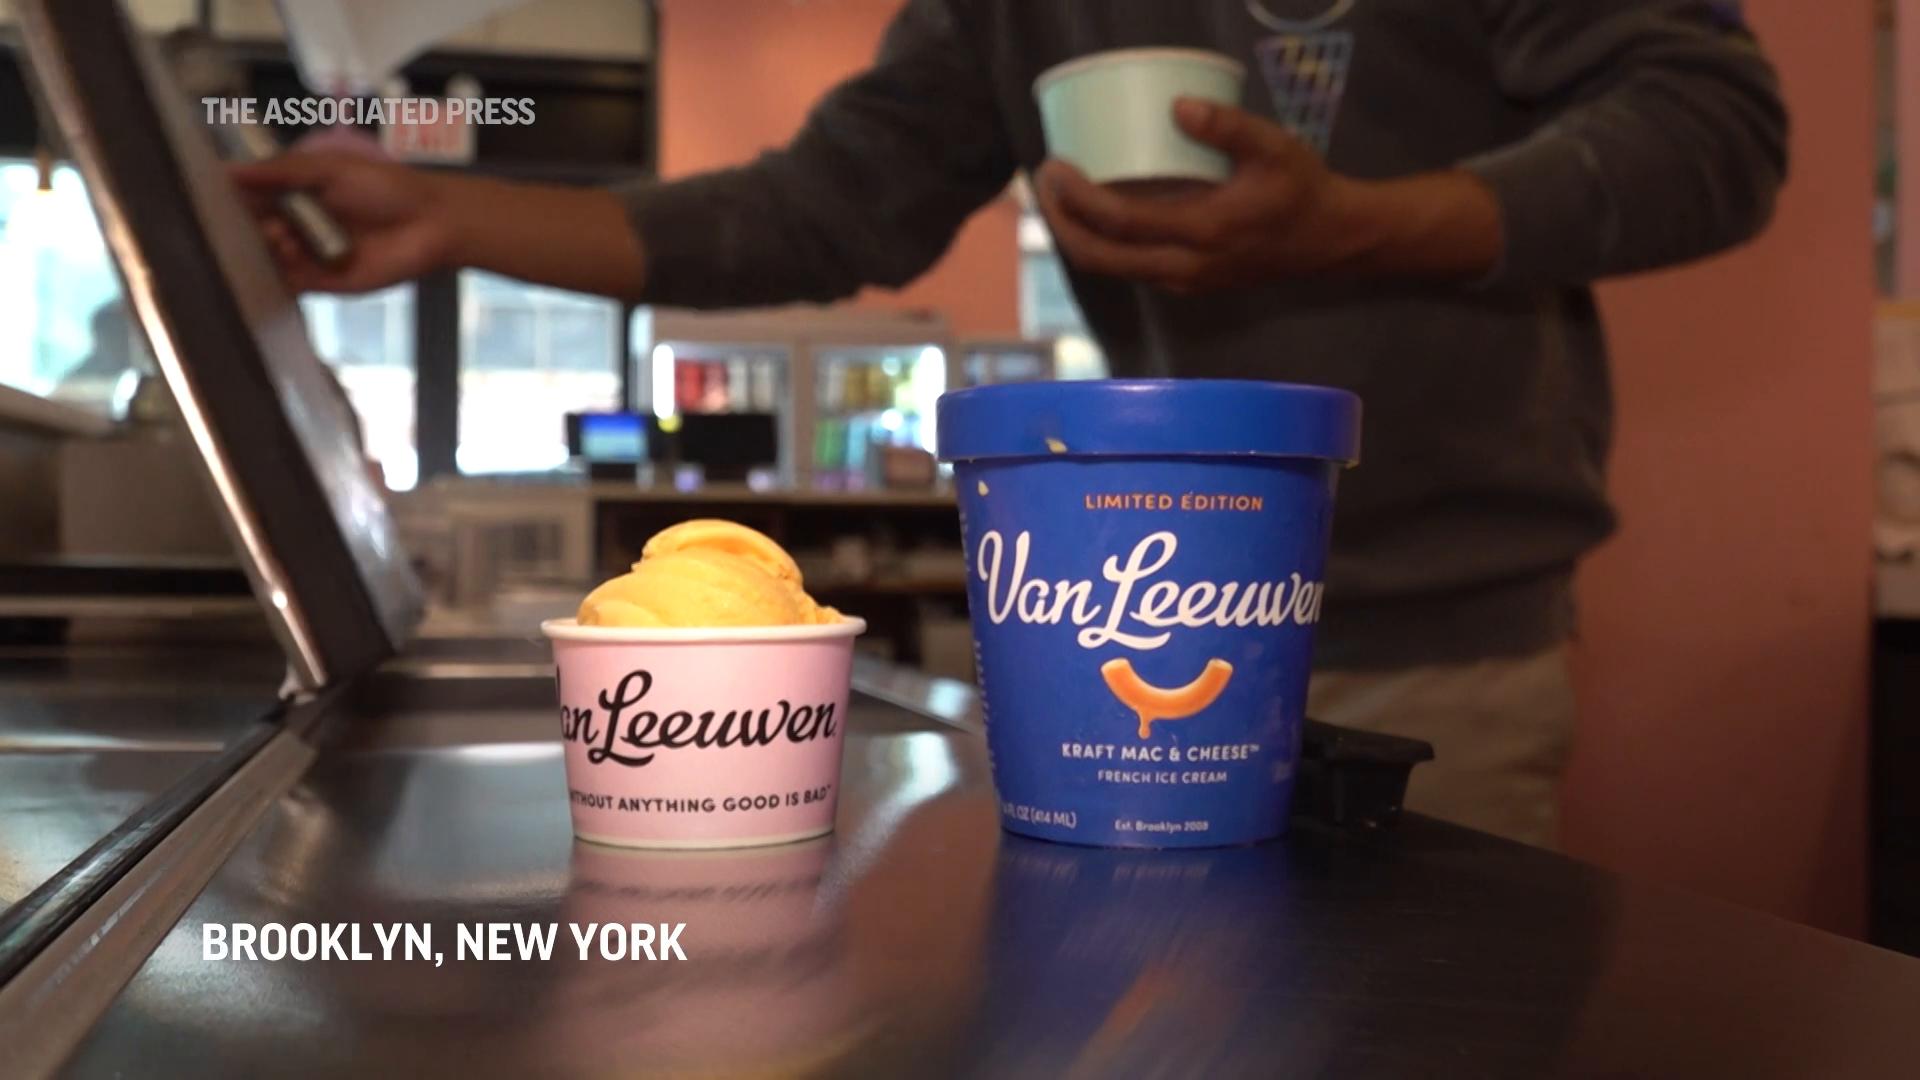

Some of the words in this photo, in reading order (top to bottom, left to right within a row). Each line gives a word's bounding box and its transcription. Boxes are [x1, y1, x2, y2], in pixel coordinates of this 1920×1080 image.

[1085, 494, 1173, 511] LIMITED
[1181, 494, 1263, 511] EDITION
[977, 531, 1101, 625] Van
[1077, 531, 1325, 650] Leeuwen
[555, 664, 599, 745] an
[1062, 743, 1116, 760] KRAFT
[1121, 745, 1163, 762] MAC
[1169, 746, 1180, 762] &
[1098, 769, 1151, 783] FRENCH
[1155, 771, 1177, 784] ICE
[1182, 771, 1228, 784] CREAM
[569, 788, 613, 810] ITHOUT
[618, 798, 715, 812] ANYTHING
[723, 796, 780, 811] GOOD
[786, 792, 799, 806] IS
[1136, 820, 1182, 834] Brooklyn
